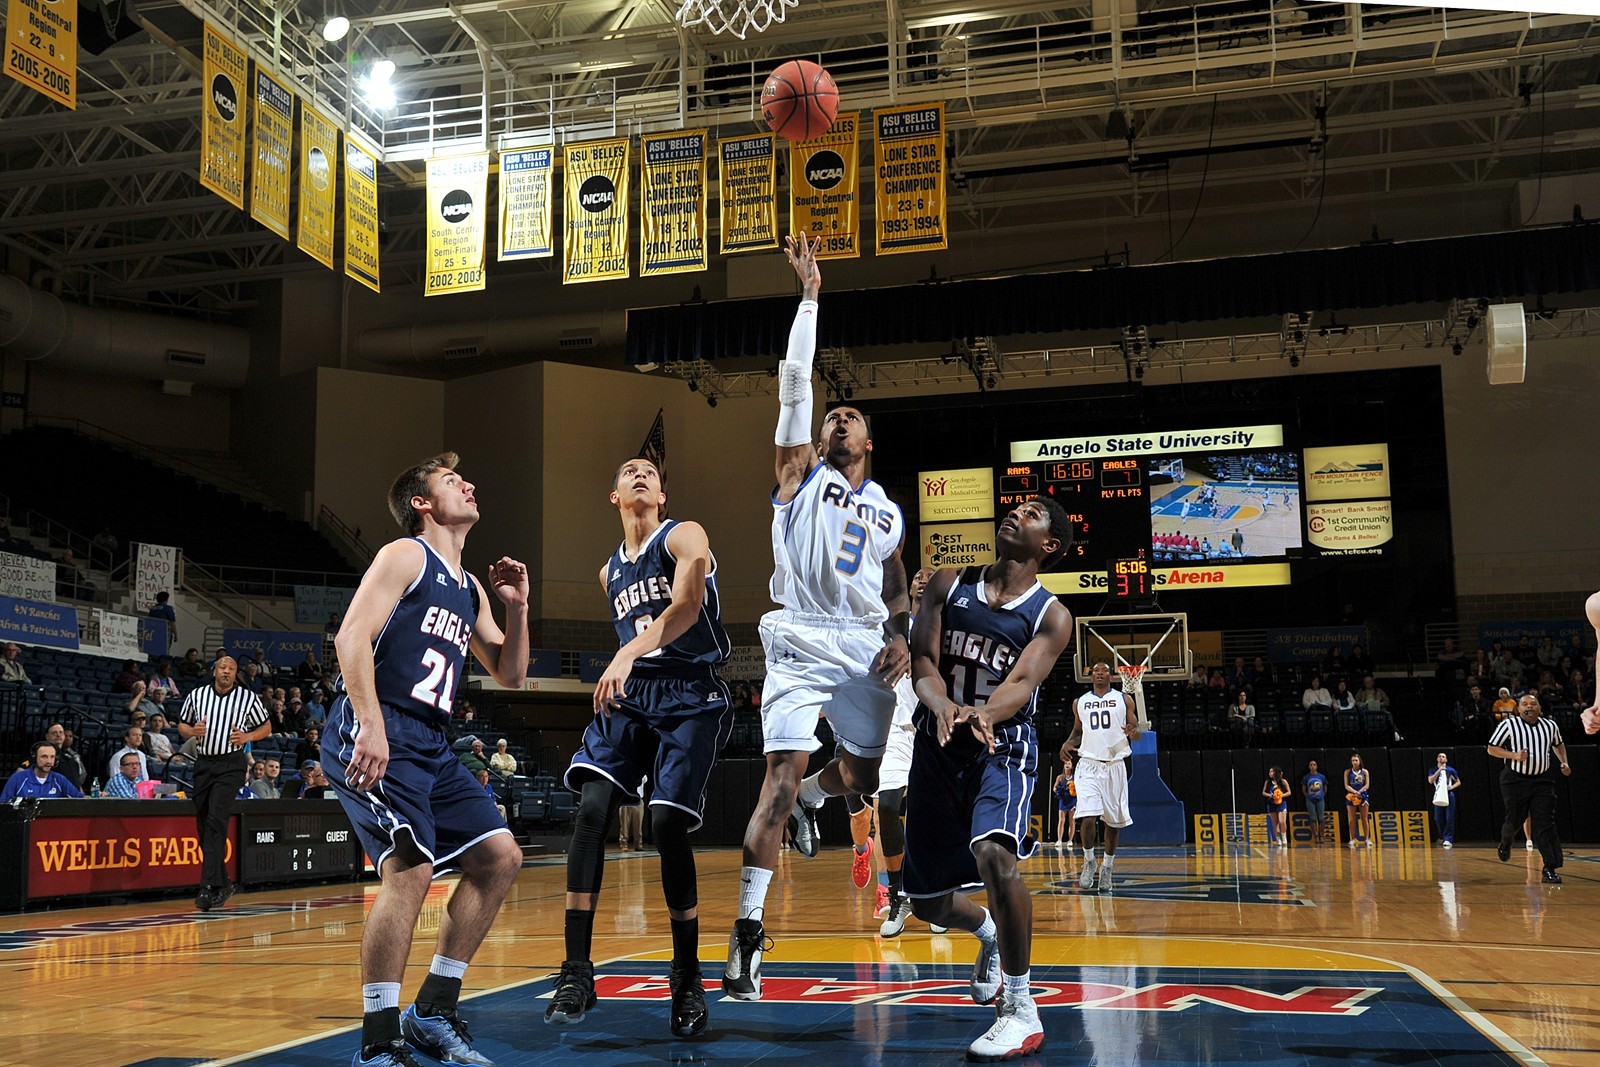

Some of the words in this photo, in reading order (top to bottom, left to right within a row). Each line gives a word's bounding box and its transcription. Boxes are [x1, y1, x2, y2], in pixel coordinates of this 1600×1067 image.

[42, 4, 72, 32] Central
[29, 12, 57, 39] Region
[11, 49, 70, 95] 2005-2006
[215, 90, 236, 115] NCAA
[882, 116, 900, 127] ASU
[902, 111, 936, 125] 'BELLES
[883, 125, 935, 135] BASKETBALL
[649, 142, 666, 153] ASU
[668, 137, 700, 150] 'BELLES
[725, 143, 740, 152] ASU
[741, 139, 769, 149] 'BELLES
[570, 151, 587, 162] ASU
[650, 150, 698, 160] BASKETBALL
[726, 149, 768, 159] BASKETBALL
[884, 147, 907, 162] LONE
[911, 144, 936, 158] STAR
[729, 167, 747, 177] LONE
[749, 165, 767, 174] STAR
[809, 168, 843, 181] NCAA
[880, 160, 941, 179] CONFERENCE
[650, 172, 672, 186] LONE
[675, 169, 699, 184] STAR
[726, 175, 771, 188] CONFERENCE
[646, 184, 703, 202] CONFERENCE
[736, 186, 760, 196] SOUTH
[885, 177, 936, 195] CHAMPION
[348, 190, 376, 220] CONFERENCE
[582, 192, 615, 205] NCAA
[724, 195, 774, 208] CO-CHAMPION
[795, 195, 820, 206] South
[822, 192, 854, 204] Central
[898, 199, 924, 212] 23-6
[651, 201, 698, 217] CHAMPION
[810, 206, 839, 217] Region
[350, 207, 374, 233] CHAMPION
[569, 219, 592, 230] South
[595, 216, 624, 227] Central
[883, 215, 940, 233] 1993-1994
[432, 227, 452, 238] South
[584, 229, 610, 240] Region
[728, 225, 770, 237] 2000-2001
[443, 235, 469, 246] Region
[646, 238, 703, 256] 2001-2002
[348, 242, 377, 270] 2003-2004
[434, 245, 477, 257] Semi-Finals
[569, 258, 625, 276] 2001-2002
[430, 270, 481, 287] 2002-2003
[1037, 441, 1100, 458] Angelo
[1106, 437, 1153, 452] State
[1159, 431, 1254, 447] University
[1007, 467, 1030, 475] RAMS
[1052, 462, 1092, 479] 16:06
[1102, 460, 1137, 469] EAGLES
[1000, 496, 1012, 504] PLY
[1015, 495, 1024, 503] FL
[1101, 490, 1114, 499] PLY
[1117, 489, 1125, 498] FL
[1127, 488, 1142, 497] PTS
[822, 482, 894, 535] RAMS
[933, 506, 979, 515] sacmc.com
[1341, 515, 1390, 524] Community
[1082, 523, 1088, 532] 2
[1334, 524, 1357, 532] Credit
[930, 533, 962, 545] WEST
[141, 544, 171, 560] PLAY
[834, 520, 869, 578] 3
[937, 543, 991, 556] CENTRAL
[1320, 548, 1383, 556] www.1cfcu.org
[140, 559, 170, 574] HARD
[931, 554, 975, 567] WIRELESS
[1115, 561, 1148, 574] 16:06
[0, 567, 23, 581] GOOD
[25, 571, 36, 581] BE
[138, 570, 166, 585] PLAY
[1168, 570, 1224, 585] Arena
[1116, 574, 1145, 597] 31
[613, 576, 672, 621] EAGLES
[14, 605, 27, 615] 4N
[29, 607, 61, 620] Ranches
[21, 623, 28, 632] &
[29, 624, 59, 636] Patricia
[60, 629, 77, 639] New
[233, 640, 264, 650] KLST
[279, 642, 315, 651] KSAN
[1295, 633, 1360, 644] Distributing
[942, 629, 1021, 672] EAGLES
[410, 647, 454, 714] 21
[950, 664, 1001, 707] 15
[1084, 700, 1117, 710] RAMS
[1090, 710, 1111, 730] 00
[1200, 816, 1214, 842] GO
[1378, 813, 1398, 842] GOLD
[1408, 812, 1425, 842] RAMS
[256, 831, 275, 843] RAMS
[326, 830, 349, 843] GUEST
[37, 838, 141, 872] WELLS
[149, 837, 232, 867] FAR
[293, 849, 298, 858] P
[307, 848, 312, 858] P
[293, 861, 298, 871] B
[307, 860, 312, 870] B
[535, 973, 1385, 1017] NCAA
